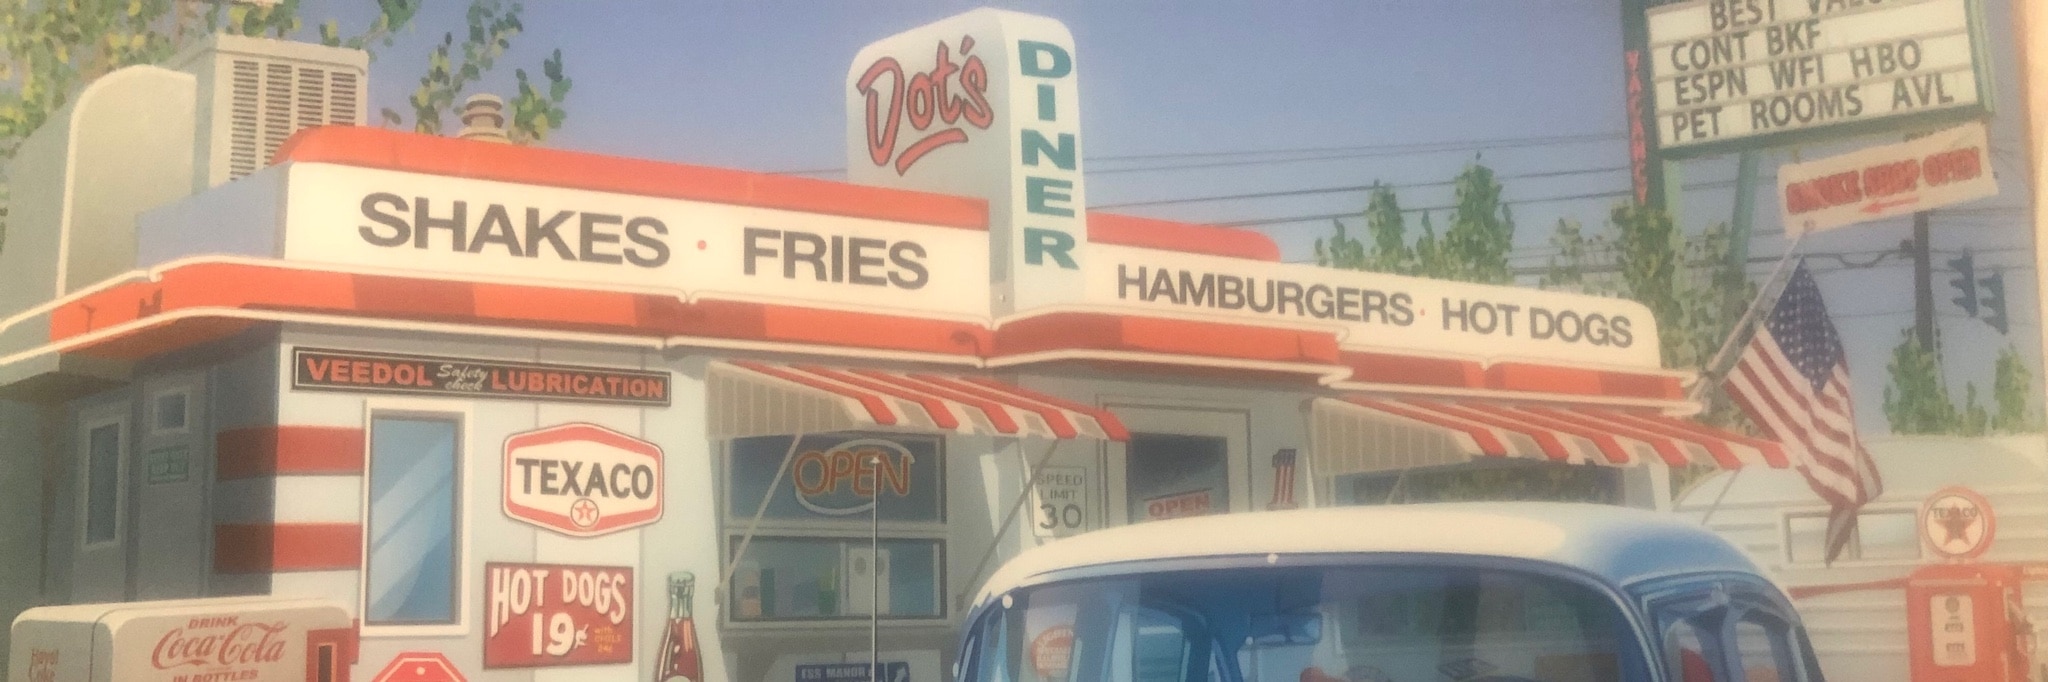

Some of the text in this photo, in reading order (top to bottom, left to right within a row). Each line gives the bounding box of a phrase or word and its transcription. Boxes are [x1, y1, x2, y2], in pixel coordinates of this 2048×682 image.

[1671, 19, 1821, 72] CONT BKF
[1674, 39, 1922, 106] ESPN WFI HBO
[856, 34, 994, 167] Dot's
[1671, 72, 1954, 142] PET ROOMS AVL
[1018, 39, 1080, 270] DINER
[358, 192, 930, 291] SHAKES FRIES
[1117, 263, 1633, 348] HAMBURGERS HOT DOGS
[306, 357, 664, 398] VEEDOL Safety LUBRICATION
[516, 457, 654, 500] TEXACO
[793, 450, 911, 496] OPEN
[1037, 473, 1083, 487] SPEED
[1040, 489, 1078, 500] LIMIT
[1039, 504, 1082, 530] 30
[1149, 492, 1210, 518] OPEN
[188, 615, 239, 630] DRINK
[491, 568, 627, 638] HOT DOGS
[152, 620, 290, 670] Coca-Cola
[194, 669, 259, 682] BOTTLES
